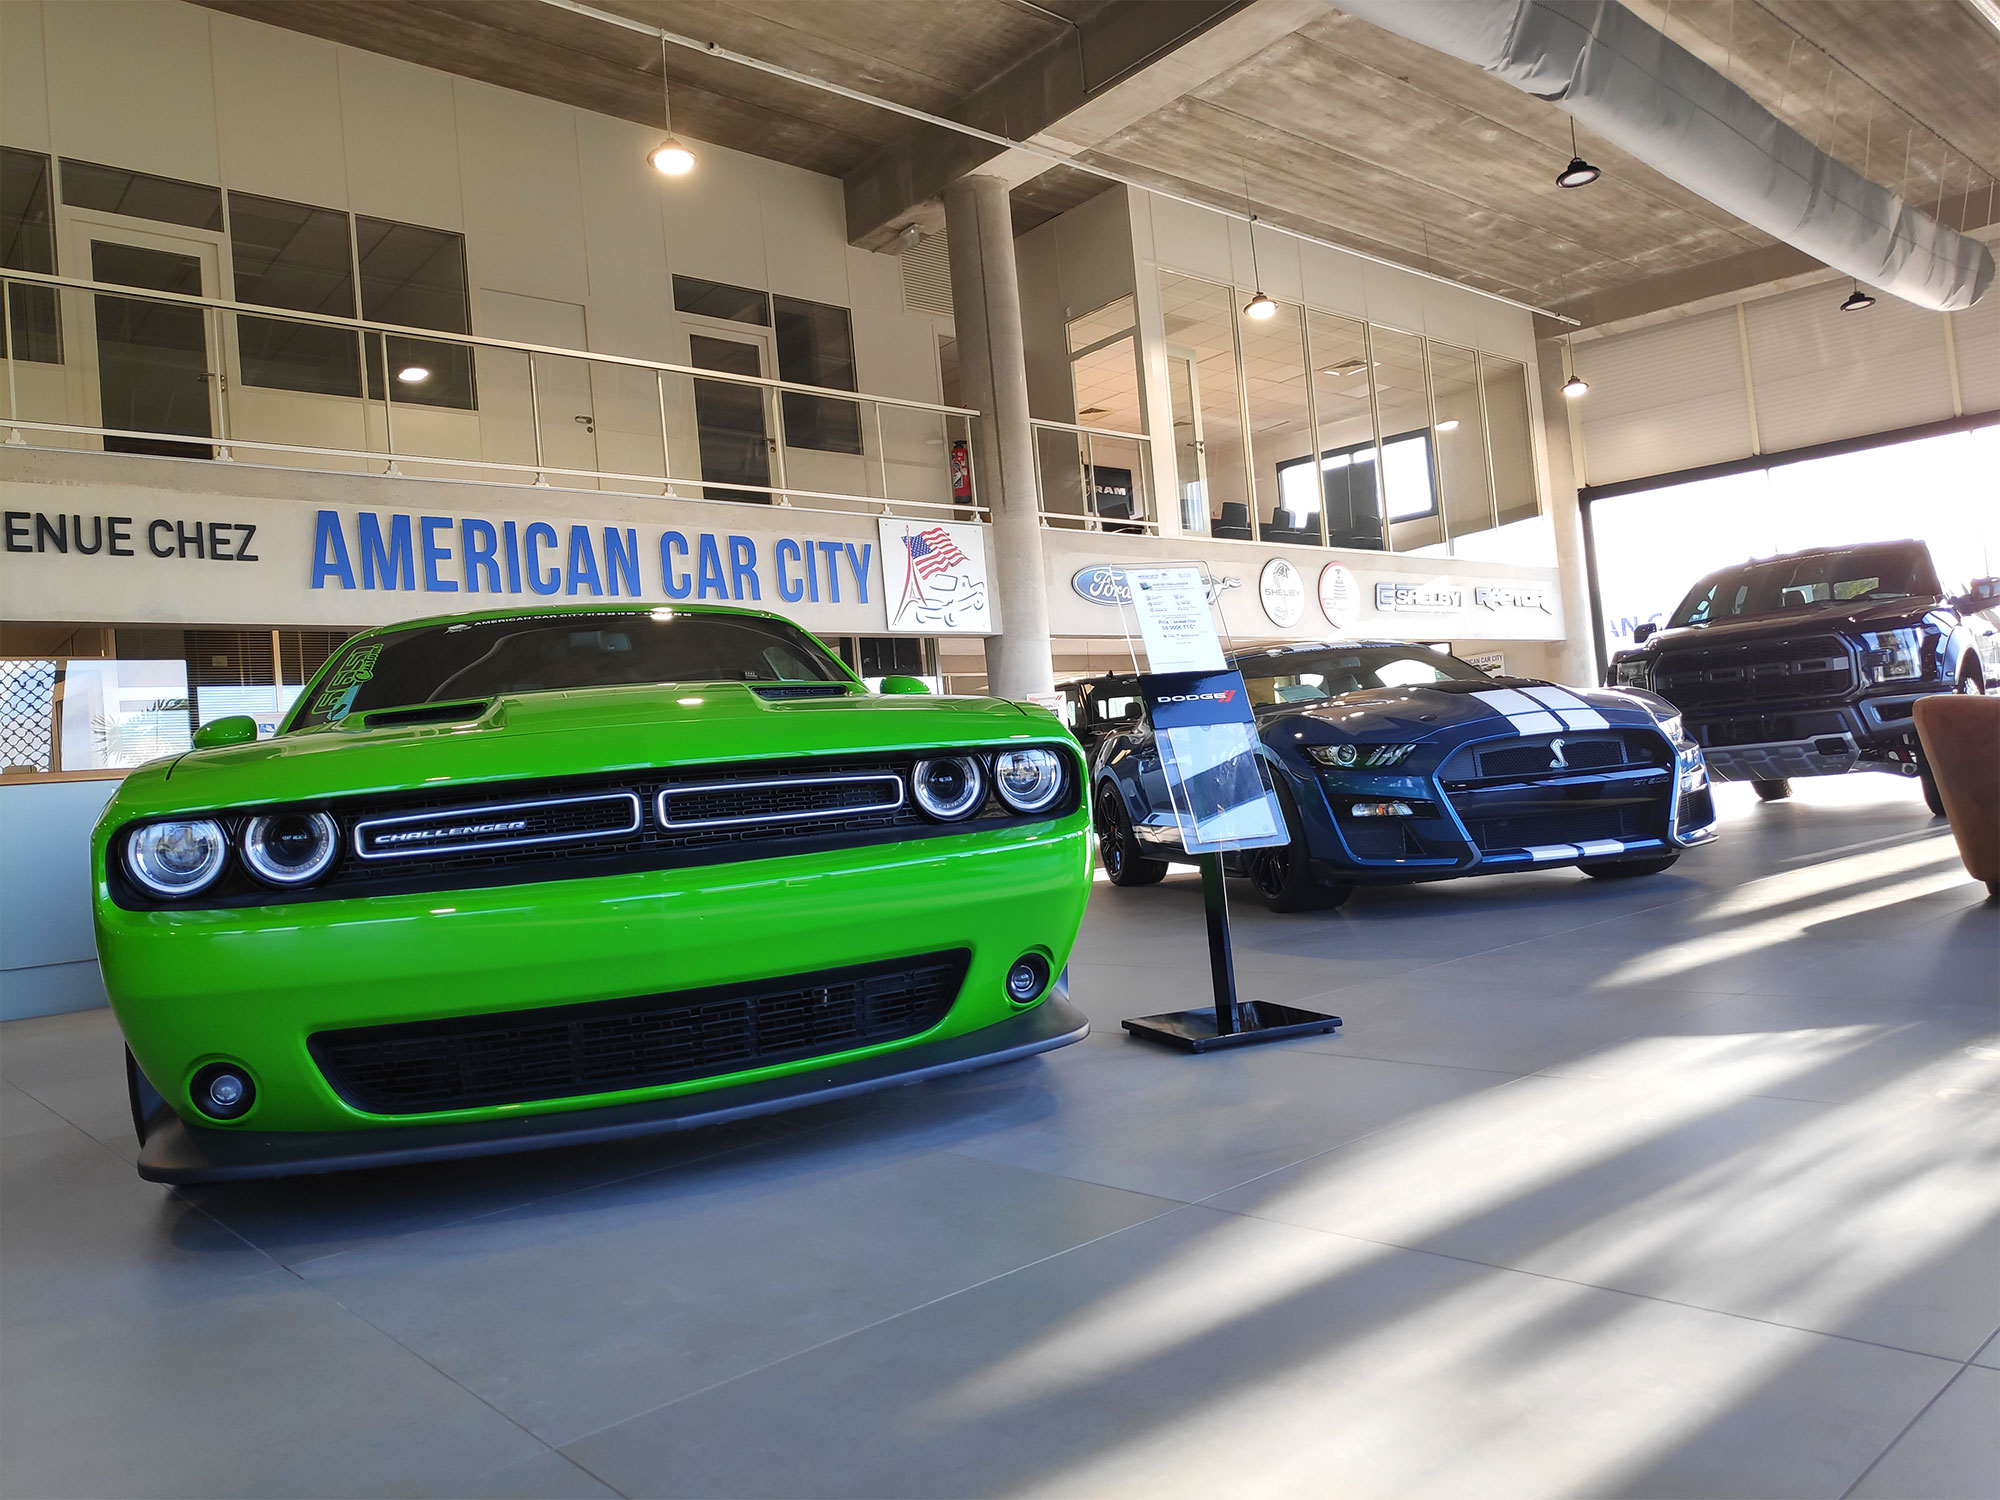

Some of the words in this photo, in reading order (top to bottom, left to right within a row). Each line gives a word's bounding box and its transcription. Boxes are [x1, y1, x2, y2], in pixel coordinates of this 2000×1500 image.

[1094, 485, 1126, 496] RAM
[5, 511, 135, 557] ENUE
[148, 519, 259, 562] CHEZ
[311, 510, 642, 598] AMERICAN
[660, 531, 761, 601] CAR
[775, 538, 872, 604] CITY
[1264, 588, 1301, 597] SHELBY
[1394, 588, 1462, 607] SHELBY
[1474, 587, 1553, 615] RAPTOR
[474, 616, 532, 626] AMERICAN
[1491, 654, 1503, 662] CITY
[1157, 692, 1227, 703] DODGE
[374, 821, 526, 845] CHALLENGER
